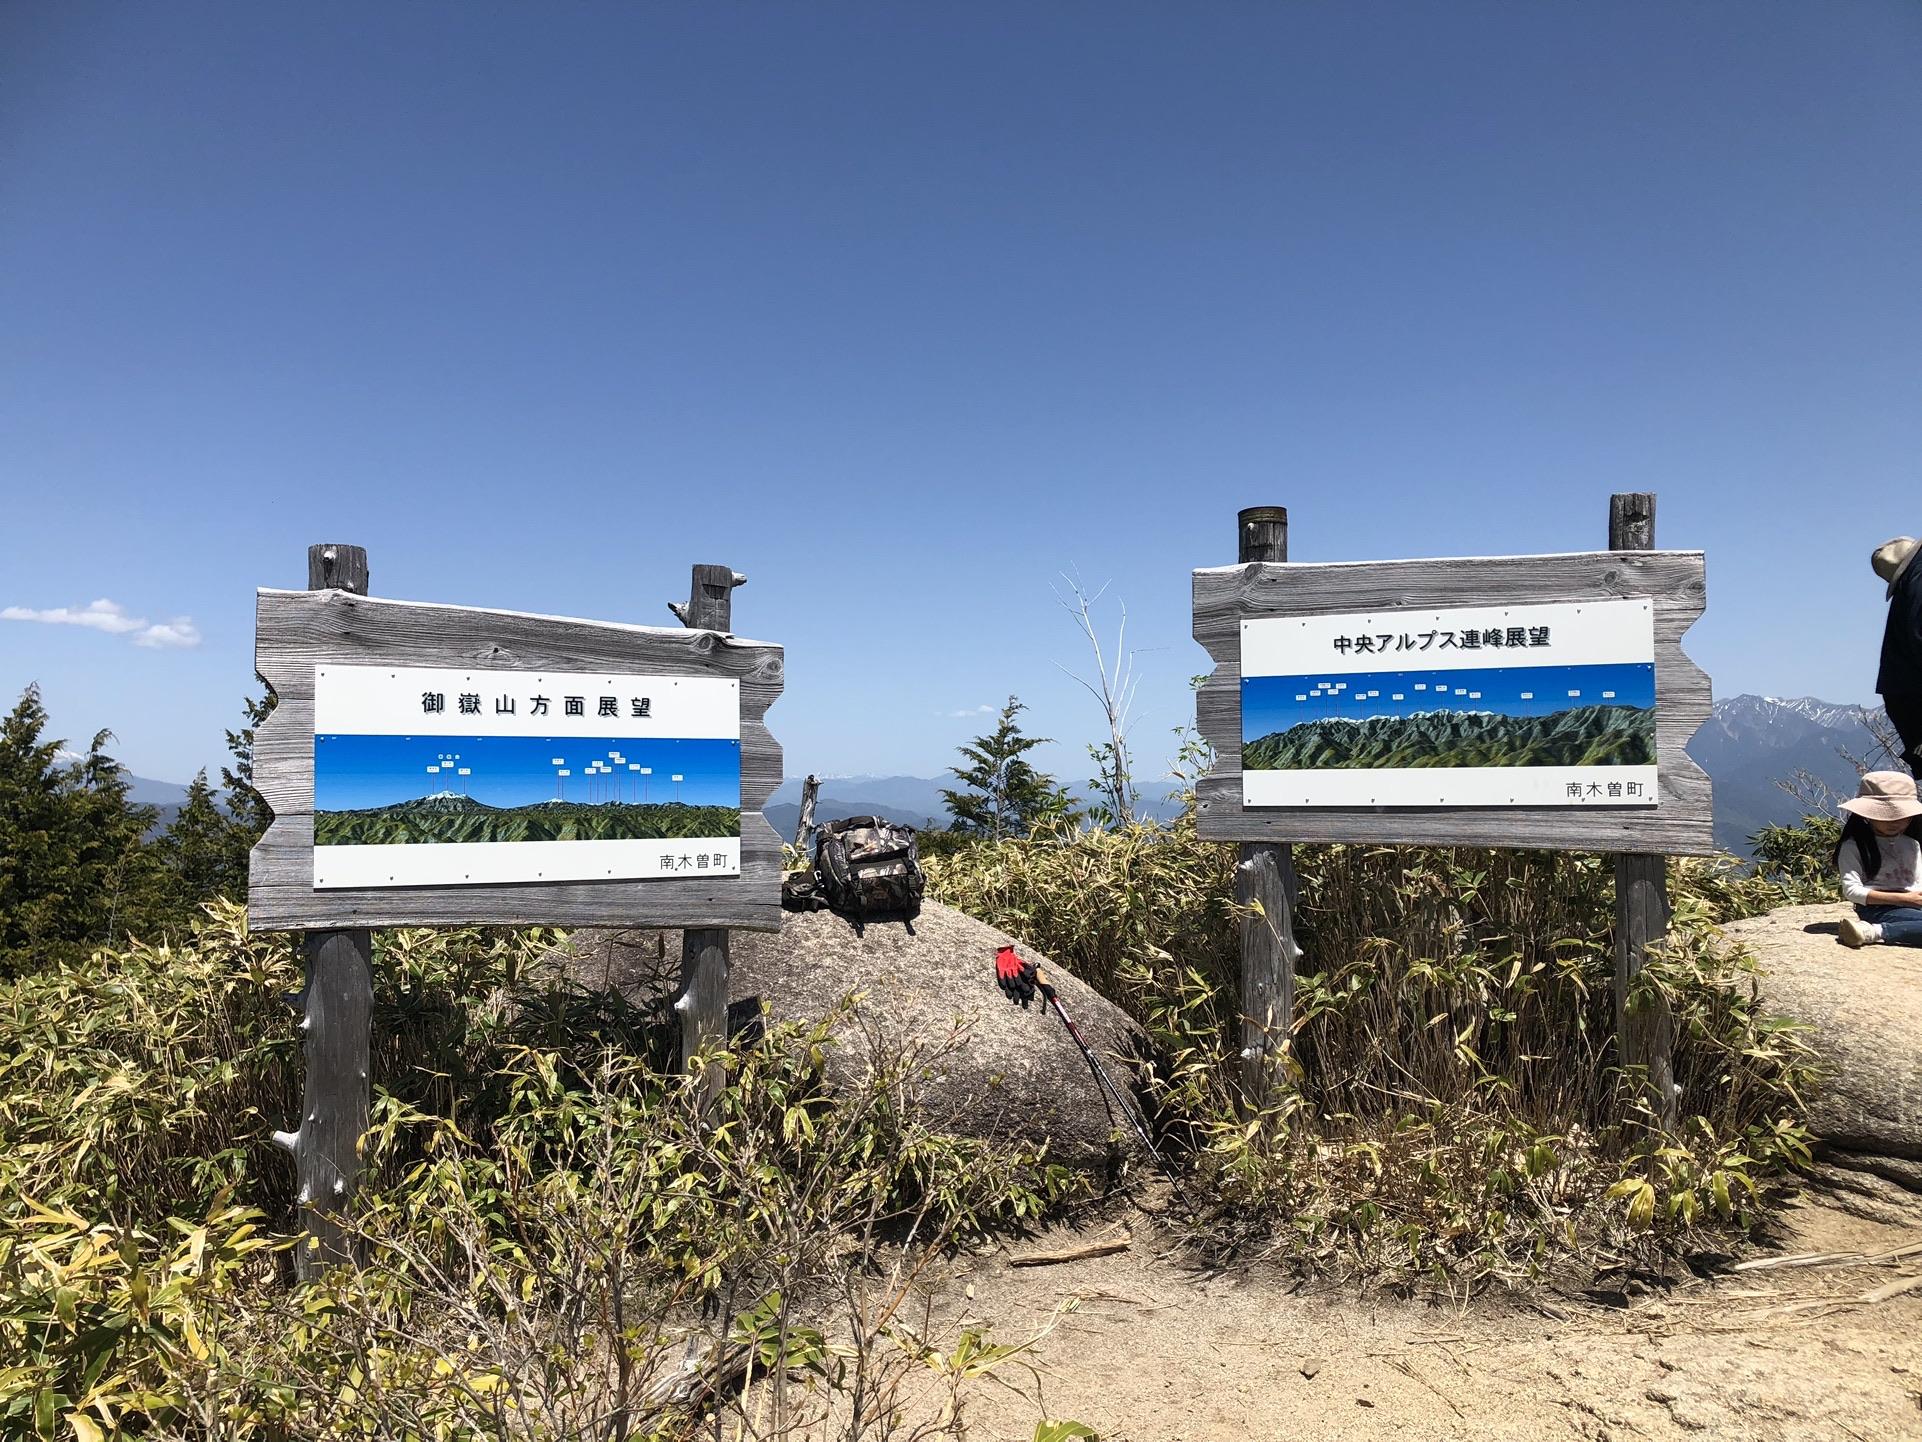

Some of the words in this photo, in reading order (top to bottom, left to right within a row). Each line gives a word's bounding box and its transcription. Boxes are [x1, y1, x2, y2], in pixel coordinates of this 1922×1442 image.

[1333, 626, 1551, 655] 中央アルプス連峰展望
[421, 691, 651, 718] 御嶽山方面展望
[1566, 781, 1644, 797] 南木曽町
[660, 853, 728, 870] 南木曽町
